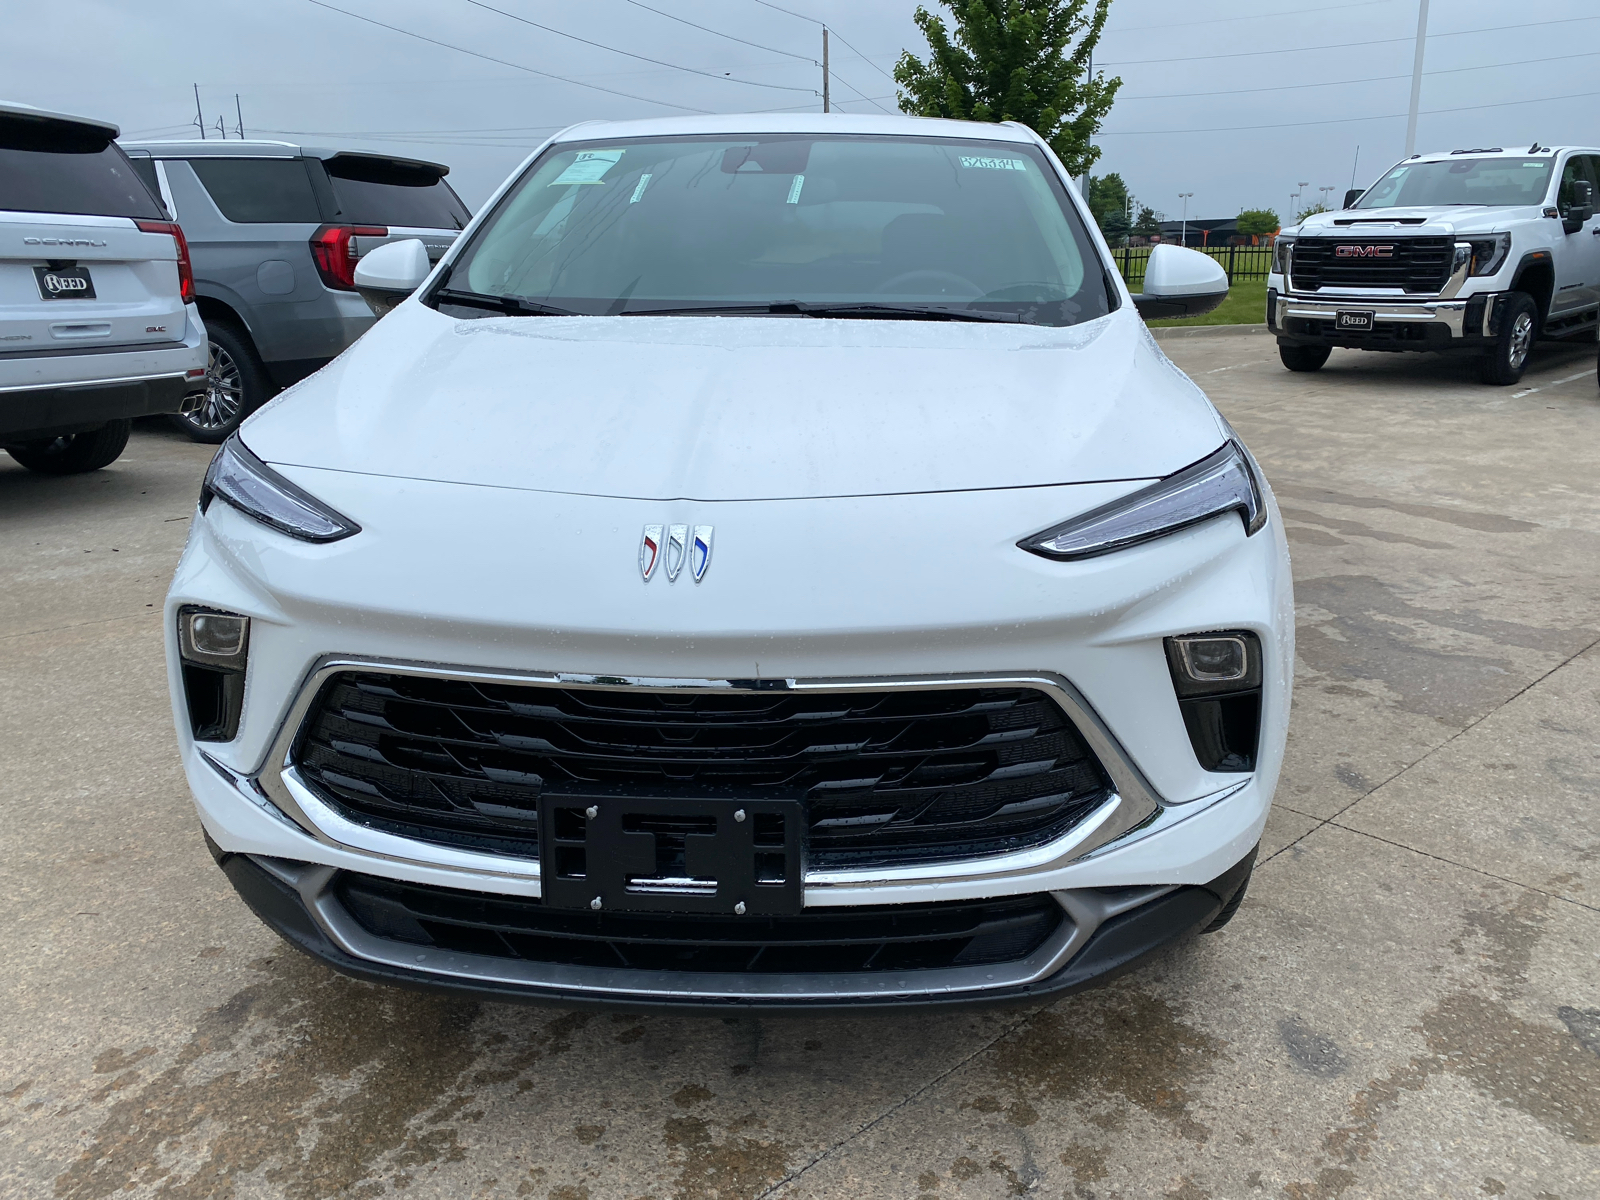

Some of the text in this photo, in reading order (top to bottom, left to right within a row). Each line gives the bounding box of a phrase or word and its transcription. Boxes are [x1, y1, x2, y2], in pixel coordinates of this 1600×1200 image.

[23, 237, 107, 247] DENALI
[1336, 245, 1394, 257] GMC
[44, 274, 87, 292] REED
[1341, 315, 1367, 326] REED
[145, 325, 166, 333] GMC
